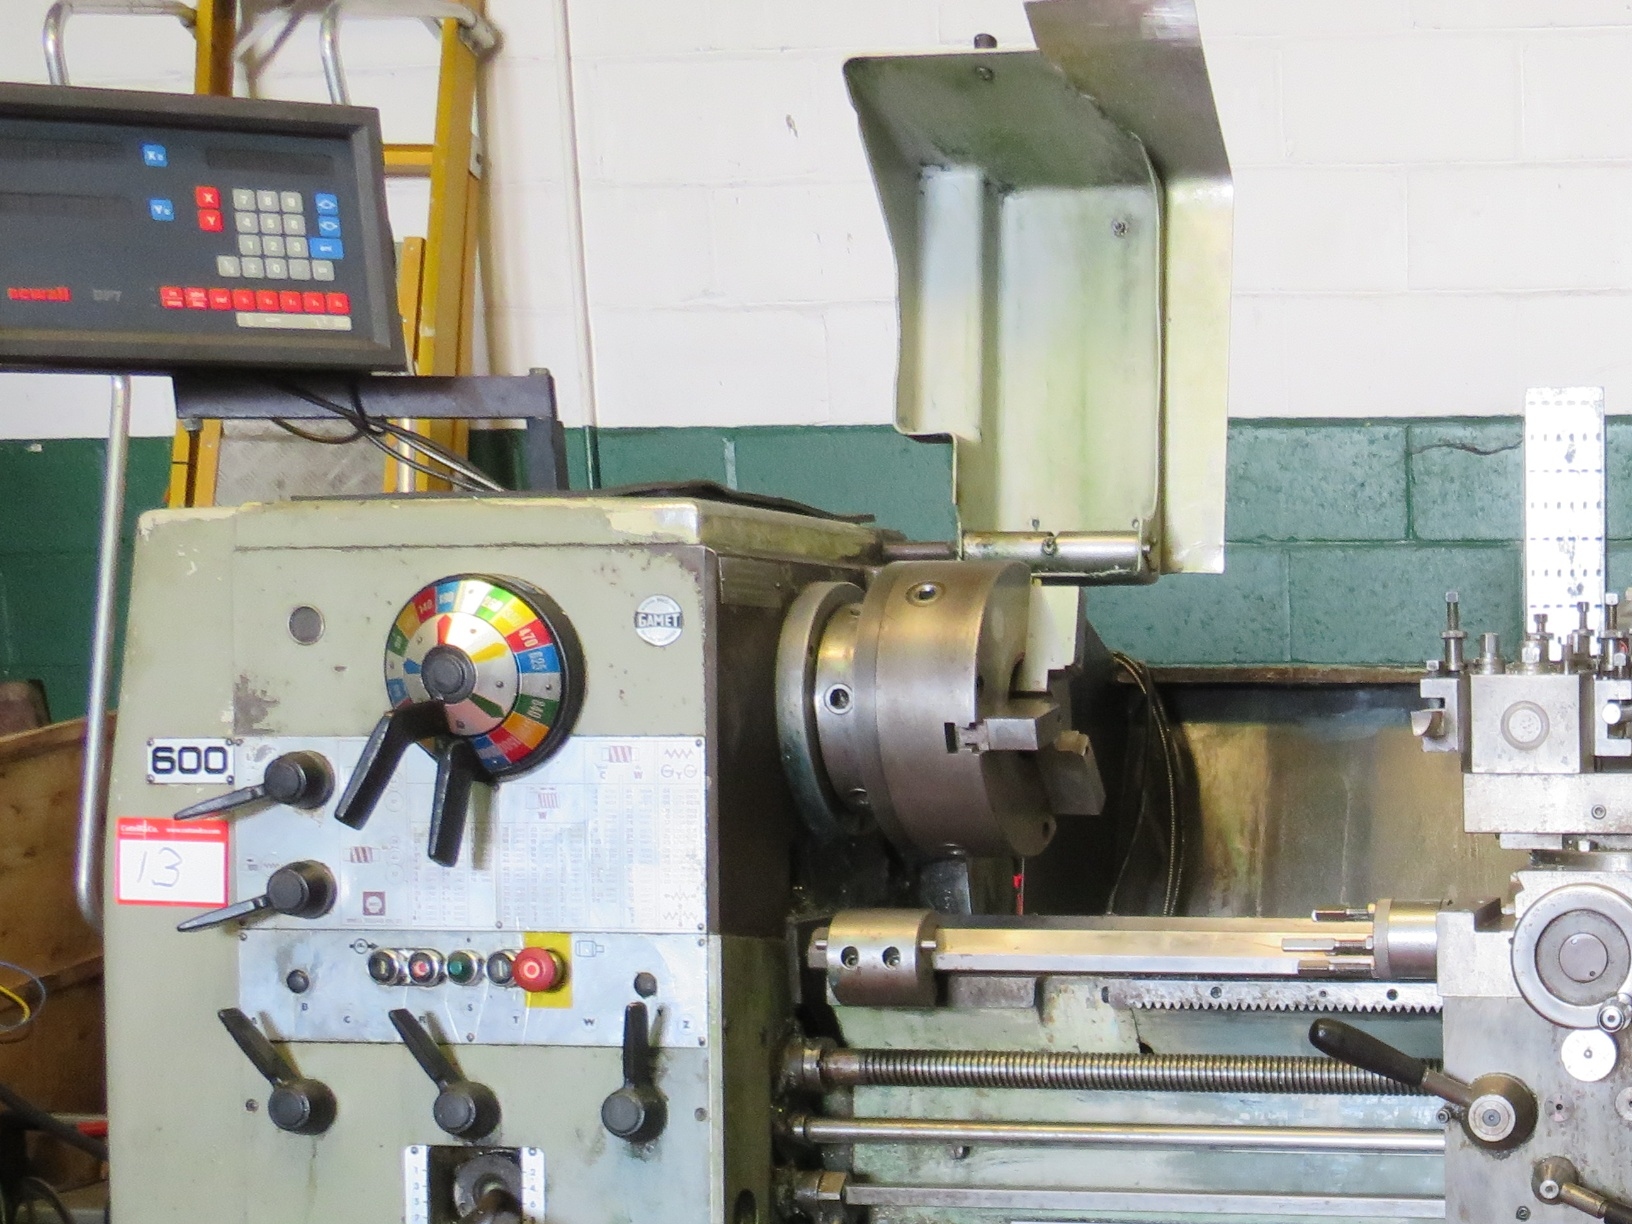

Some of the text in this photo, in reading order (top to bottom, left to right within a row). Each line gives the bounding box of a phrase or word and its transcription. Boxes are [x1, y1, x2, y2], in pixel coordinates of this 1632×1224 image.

[204, 193, 213, 203] X
[240, 196, 248, 205] 7
[264, 195, 272, 206] 8
[207, 215, 216, 226] Y
[243, 217, 252, 227] 4
[270, 241, 278, 251] 2
[293, 241, 301, 252] 3
[638, 613, 681, 628] GAMET
[518, 627, 539, 648] 470
[526, 699, 546, 719] 840
[152, 746, 228, 775] 600
[137, 846, 183, 888] 13
[301, 1002, 309, 1011] B
[467, 1003, 473, 1012] S
[343, 1015, 351, 1024] C
[418, 1015, 426, 1024] R
[512, 1015, 519, 1024] T
[583, 1017, 595, 1026] W
[682, 1020, 690, 1029] Z
